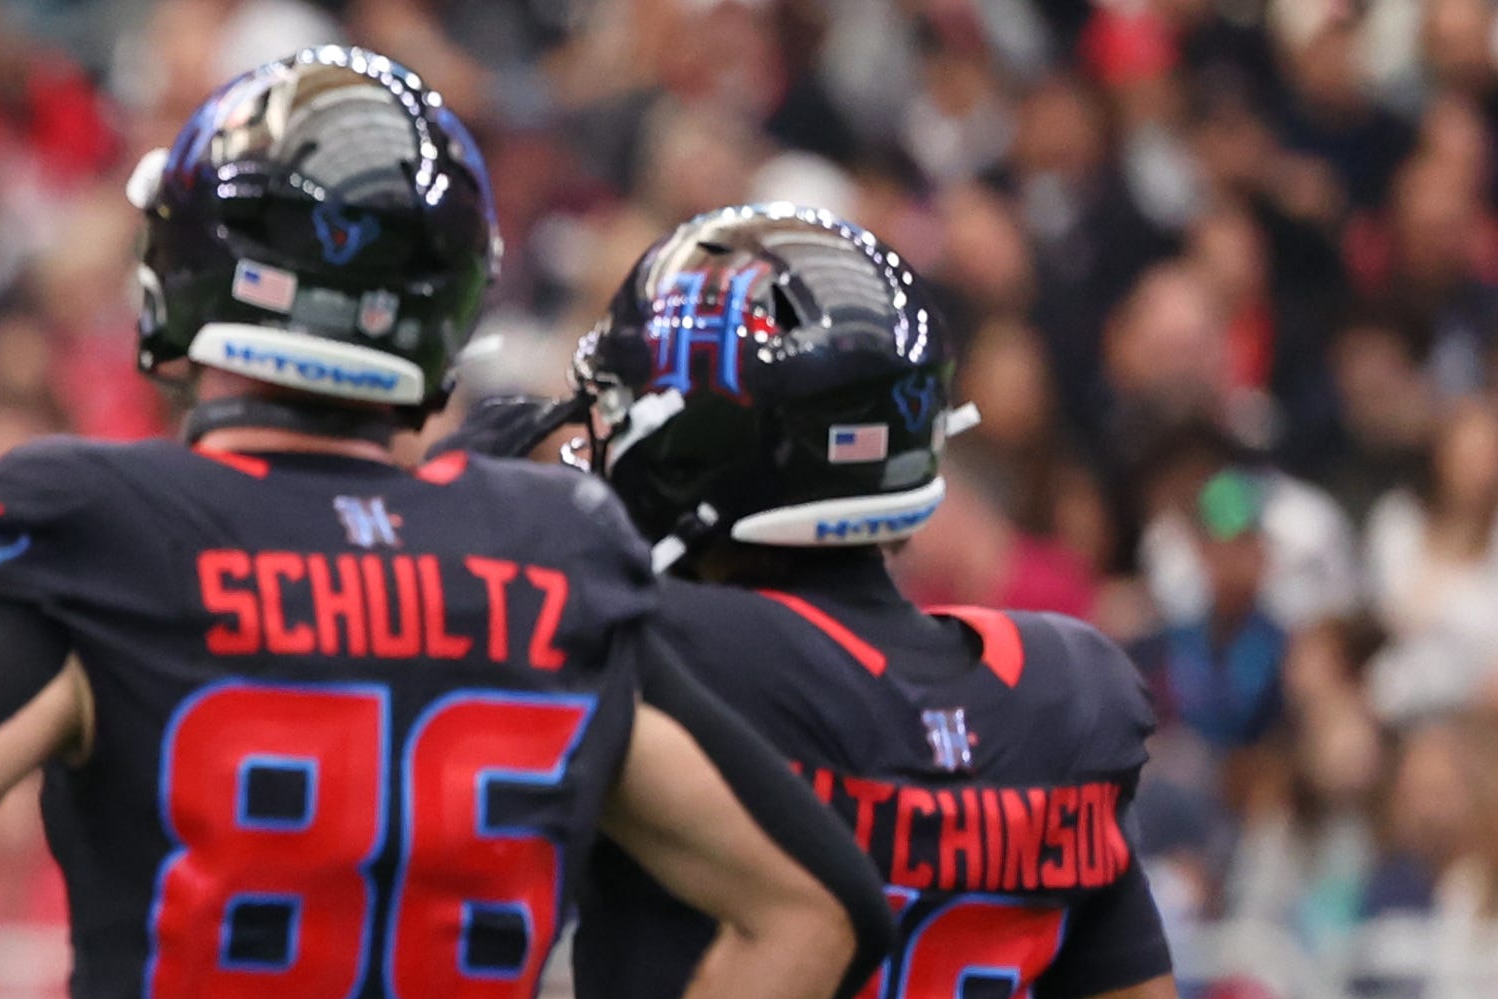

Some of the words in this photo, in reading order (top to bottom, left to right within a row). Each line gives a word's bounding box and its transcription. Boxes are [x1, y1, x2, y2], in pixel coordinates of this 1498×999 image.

[816, 500, 939, 541] H-TO
[196, 549, 569, 671] SCHULTZ
[790, 760, 1128, 890] TCHINSON
